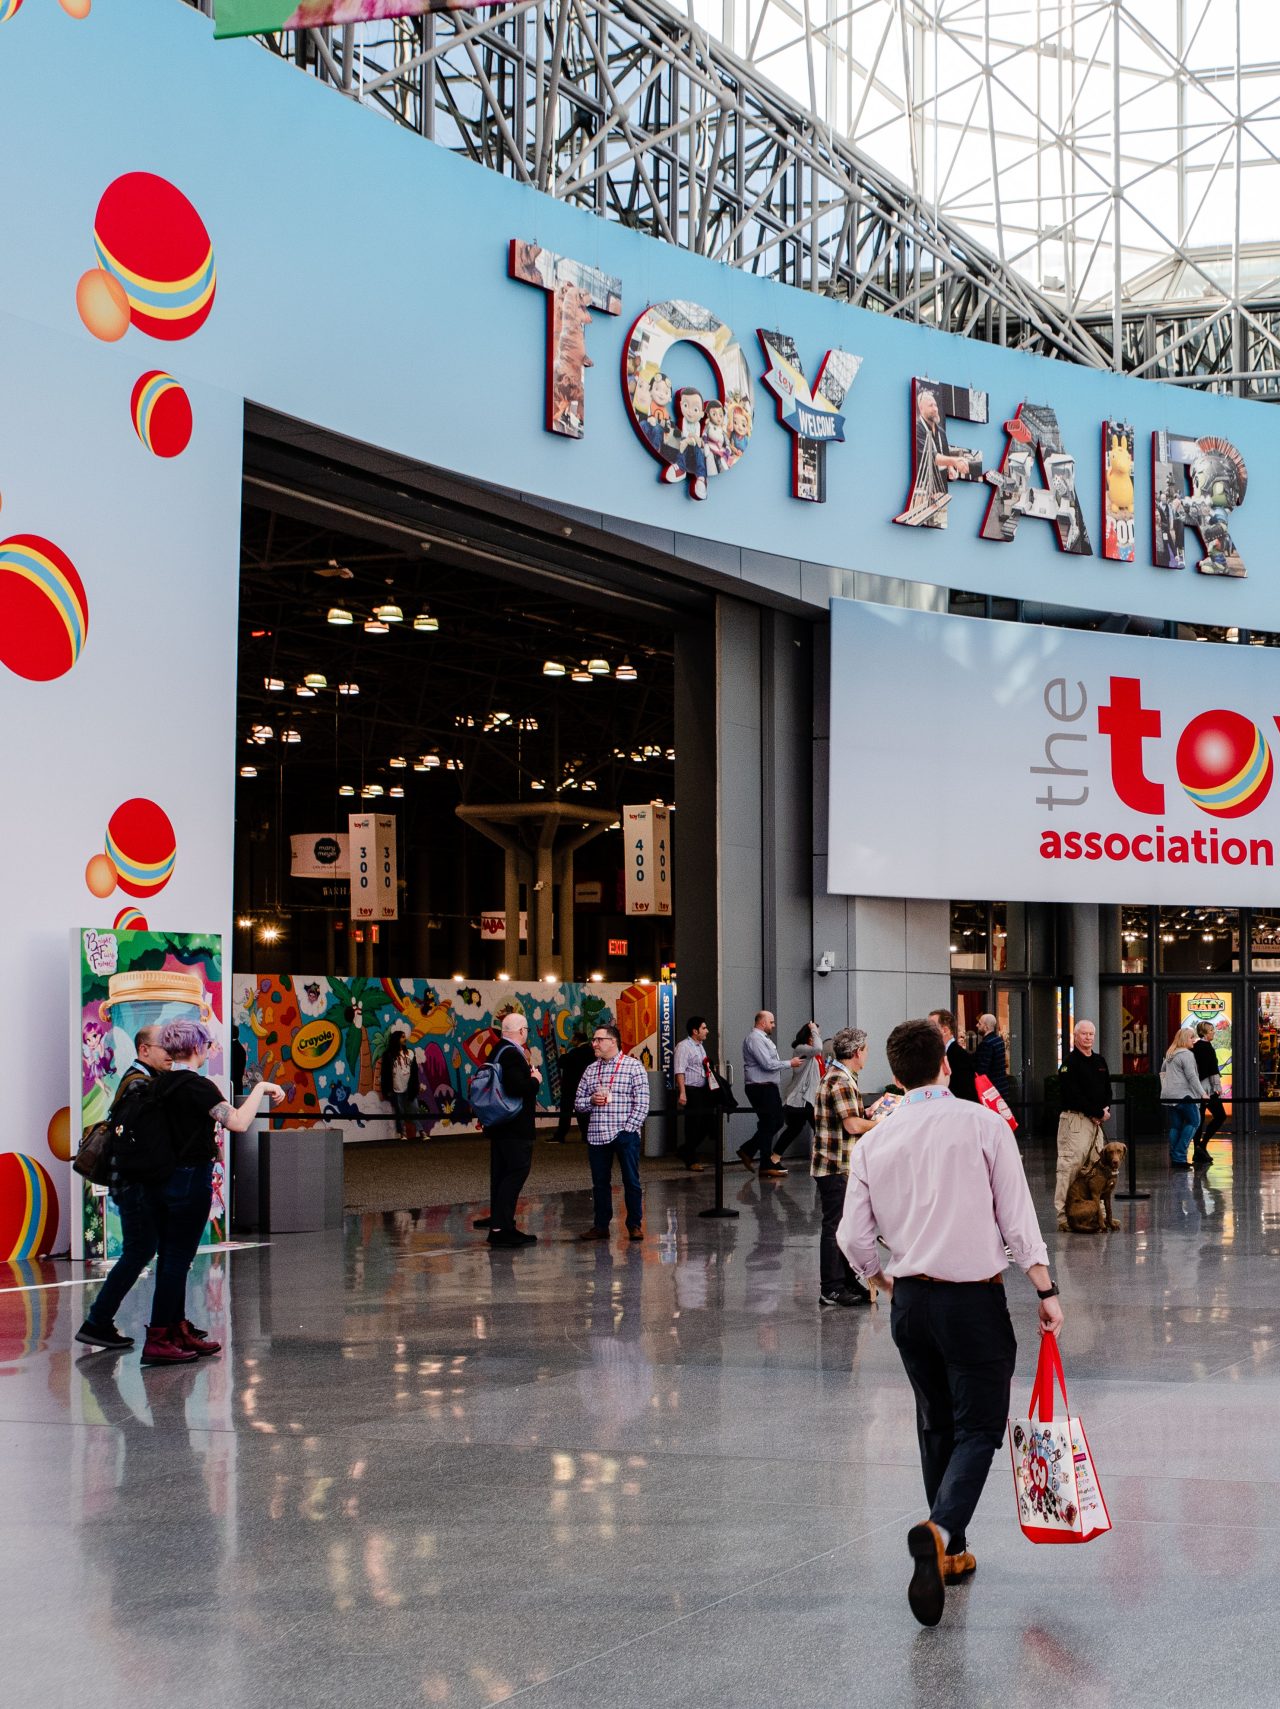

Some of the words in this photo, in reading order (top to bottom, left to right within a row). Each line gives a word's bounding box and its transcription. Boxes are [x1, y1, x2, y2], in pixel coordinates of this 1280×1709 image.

[508, 239, 862, 503] TOY
[892, 376, 1248, 579] FAIR
[798, 408, 836, 436] WELCOME
[1030, 677, 1089, 811] the
[635, 839, 644, 881] 400
[1039, 825, 1274, 866] association
[360, 847, 368, 888] 300
[609, 940, 628, 955] EXIT
[299, 1031, 332, 1050] Crayola
[1030, 1456, 1047, 1490] ty
